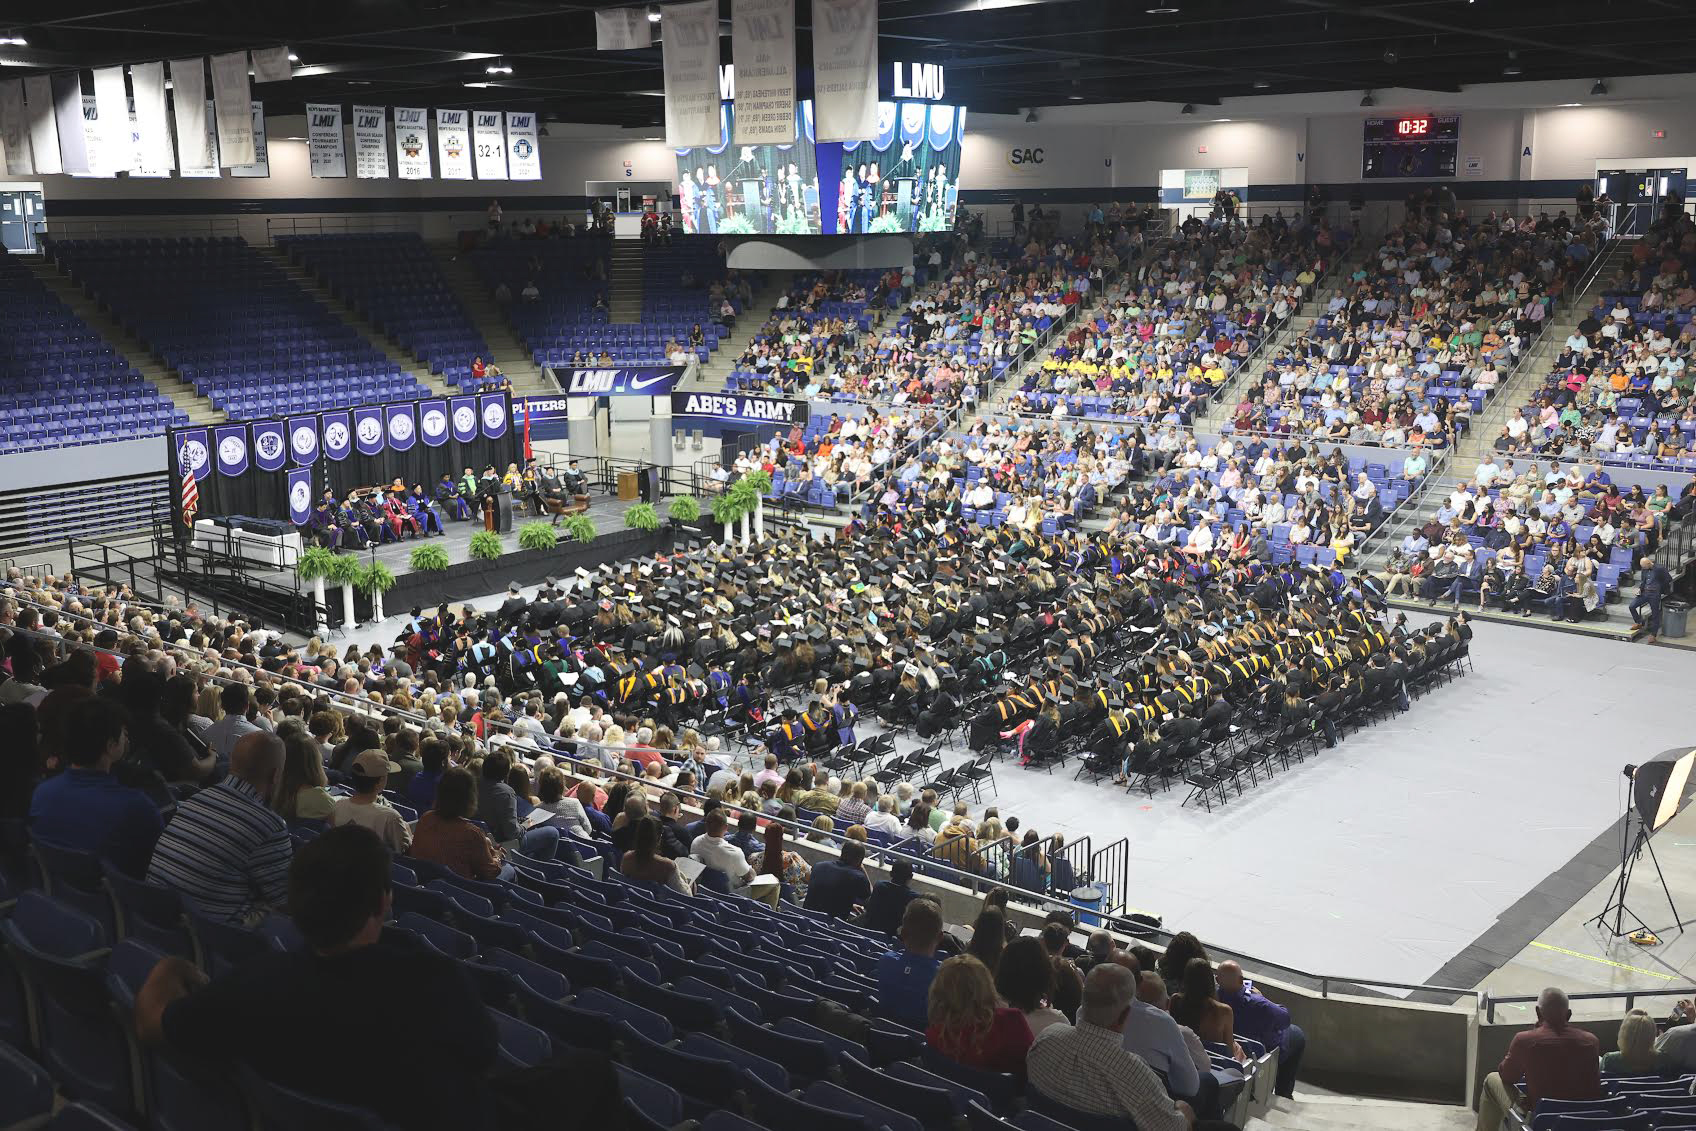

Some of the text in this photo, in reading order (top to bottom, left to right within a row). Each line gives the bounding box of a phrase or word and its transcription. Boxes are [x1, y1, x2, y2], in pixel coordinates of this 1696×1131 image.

[894, 61, 944, 100] LMU
[312, 114, 335, 127] LMU
[358, 115, 380, 128] LMU
[399, 110, 423, 123] LMU
[441, 112, 462, 124] LMU
[478, 115, 497, 127] LMU
[511, 116, 531, 128] LMU
[1398, 119, 1428, 134] 10:32
[1011, 148, 1044, 165] SAC
[1297, 153, 1305, 162] V
[1522, 147, 1532, 156] A
[1104, 158, 1112, 168] U
[406, 167, 421, 175] 2016
[569, 369, 620, 395] LMU
[512, 400, 567, 414] PLTTERS
[685, 395, 796, 421] ABE'S ARMY
